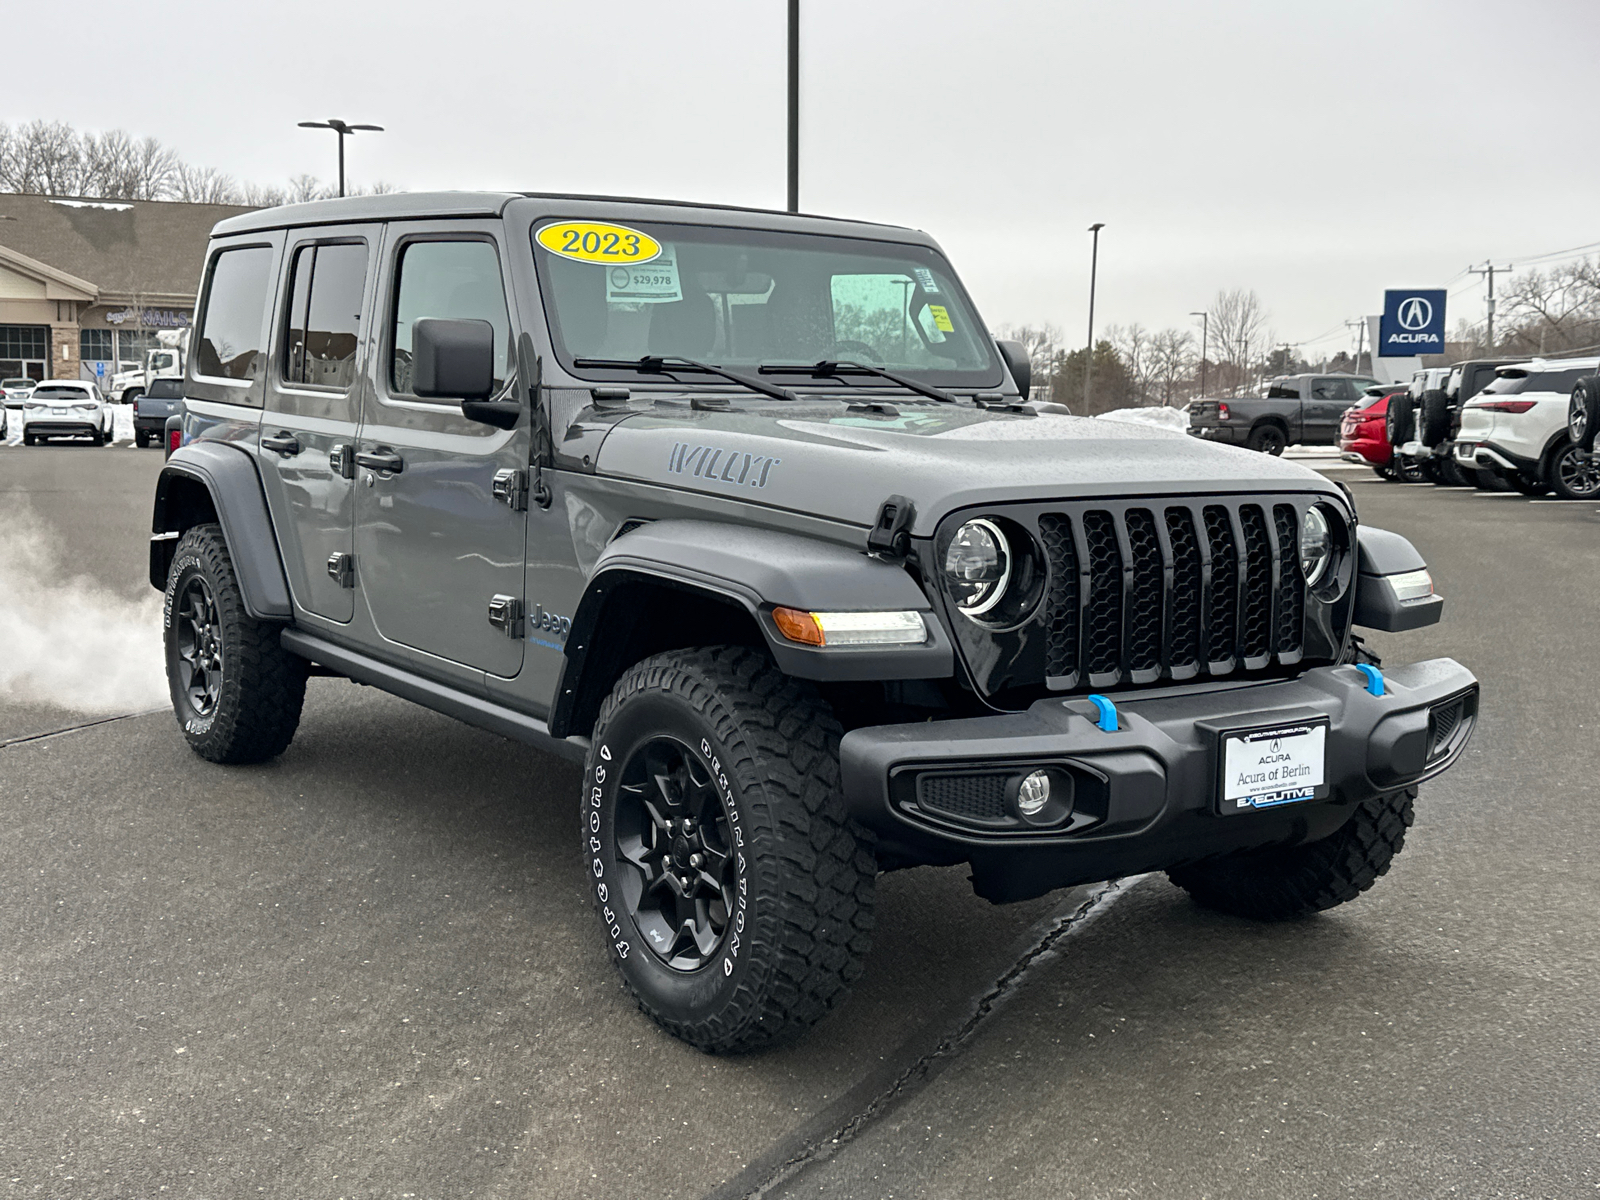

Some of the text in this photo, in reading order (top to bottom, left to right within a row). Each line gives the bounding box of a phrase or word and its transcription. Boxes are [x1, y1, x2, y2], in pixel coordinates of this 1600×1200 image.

[561, 229, 641, 257] 2023
[633, 275, 672, 286] $29,978
[141, 310, 189, 327] NAILS
[1387, 333, 1440, 344] ACURA
[668, 442, 781, 488] WILLYS
[530, 603, 572, 642] Jeep
[1258, 753, 1292, 765] ACURA
[1236, 763, 1311, 786] Acura of Berlin
[1236, 786, 1315, 808] EXECUTIVE
[700, 737, 748, 960] DESTINATION
